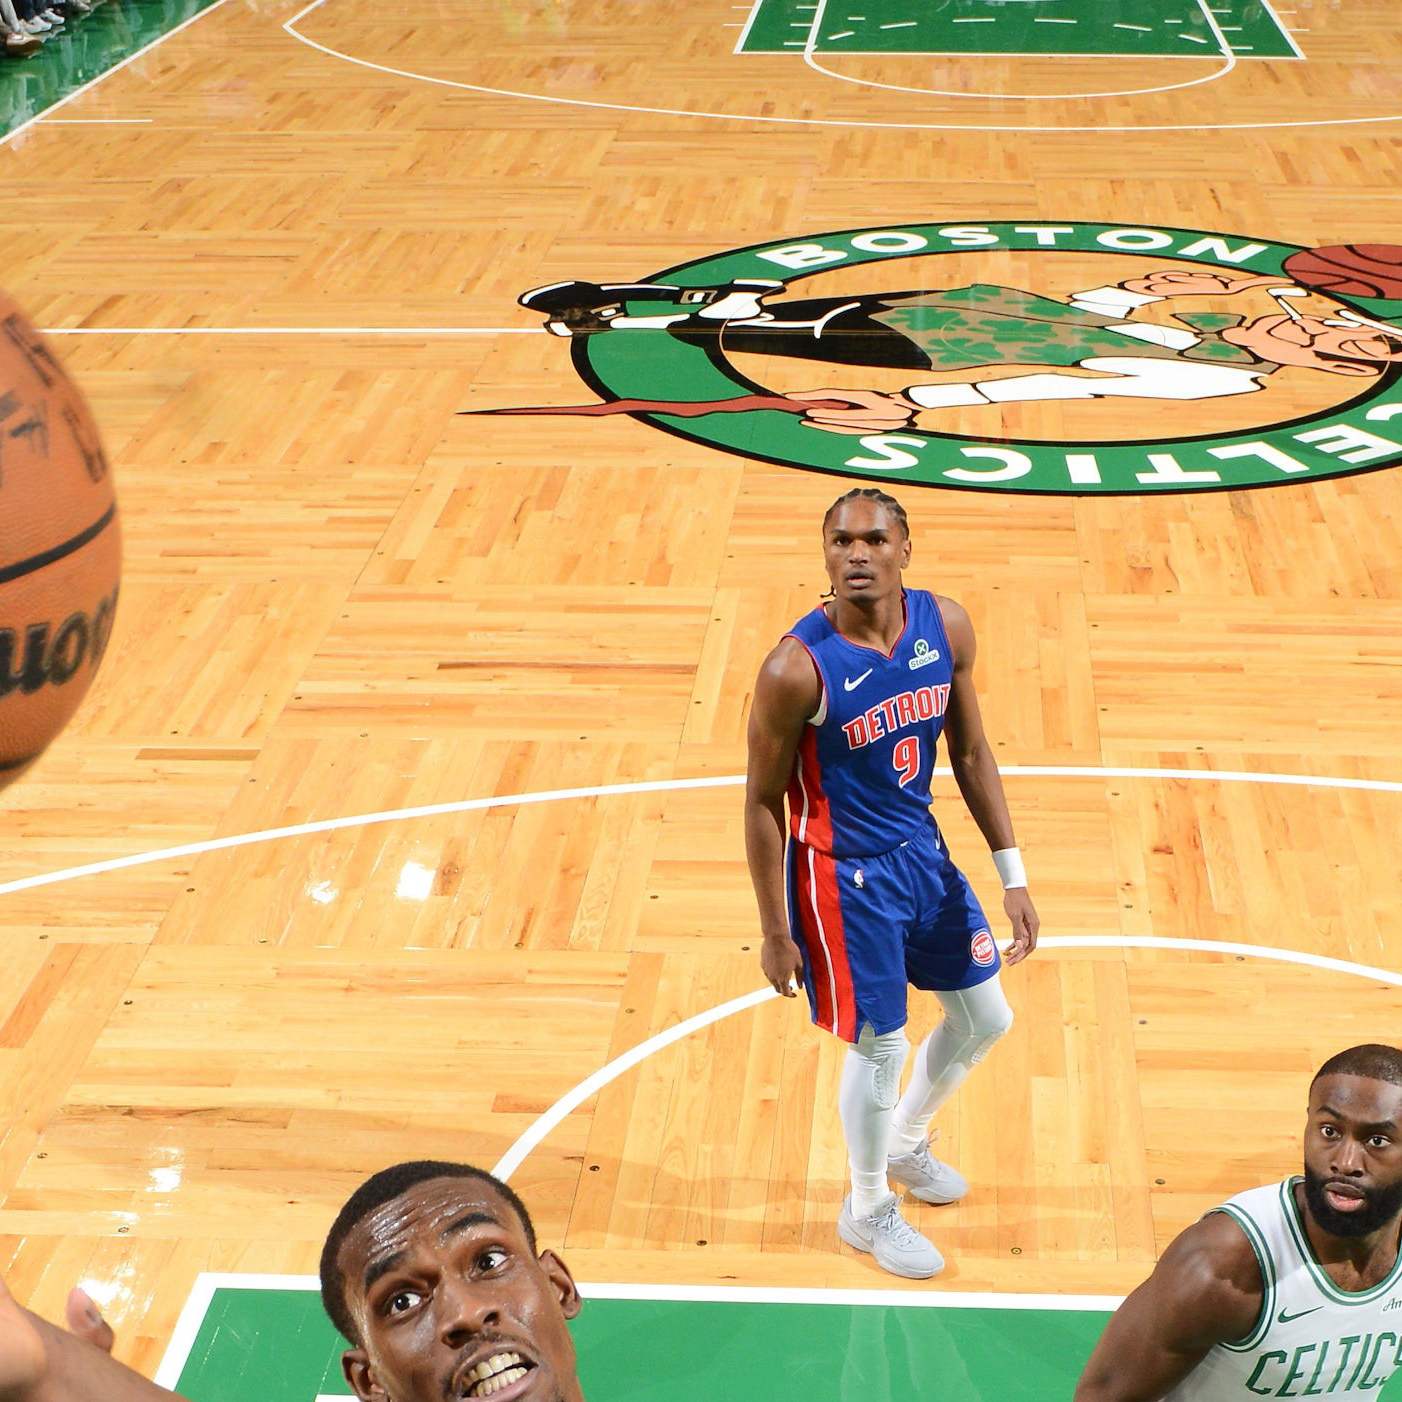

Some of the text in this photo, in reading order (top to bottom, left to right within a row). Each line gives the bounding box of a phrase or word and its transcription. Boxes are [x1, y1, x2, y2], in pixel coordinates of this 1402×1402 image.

[755, 226, 1268, 270] BOSTON
[910, 652, 939, 668] StockX
[841, 682, 951, 750] DETROIT
[893, 736, 919, 788] 9
